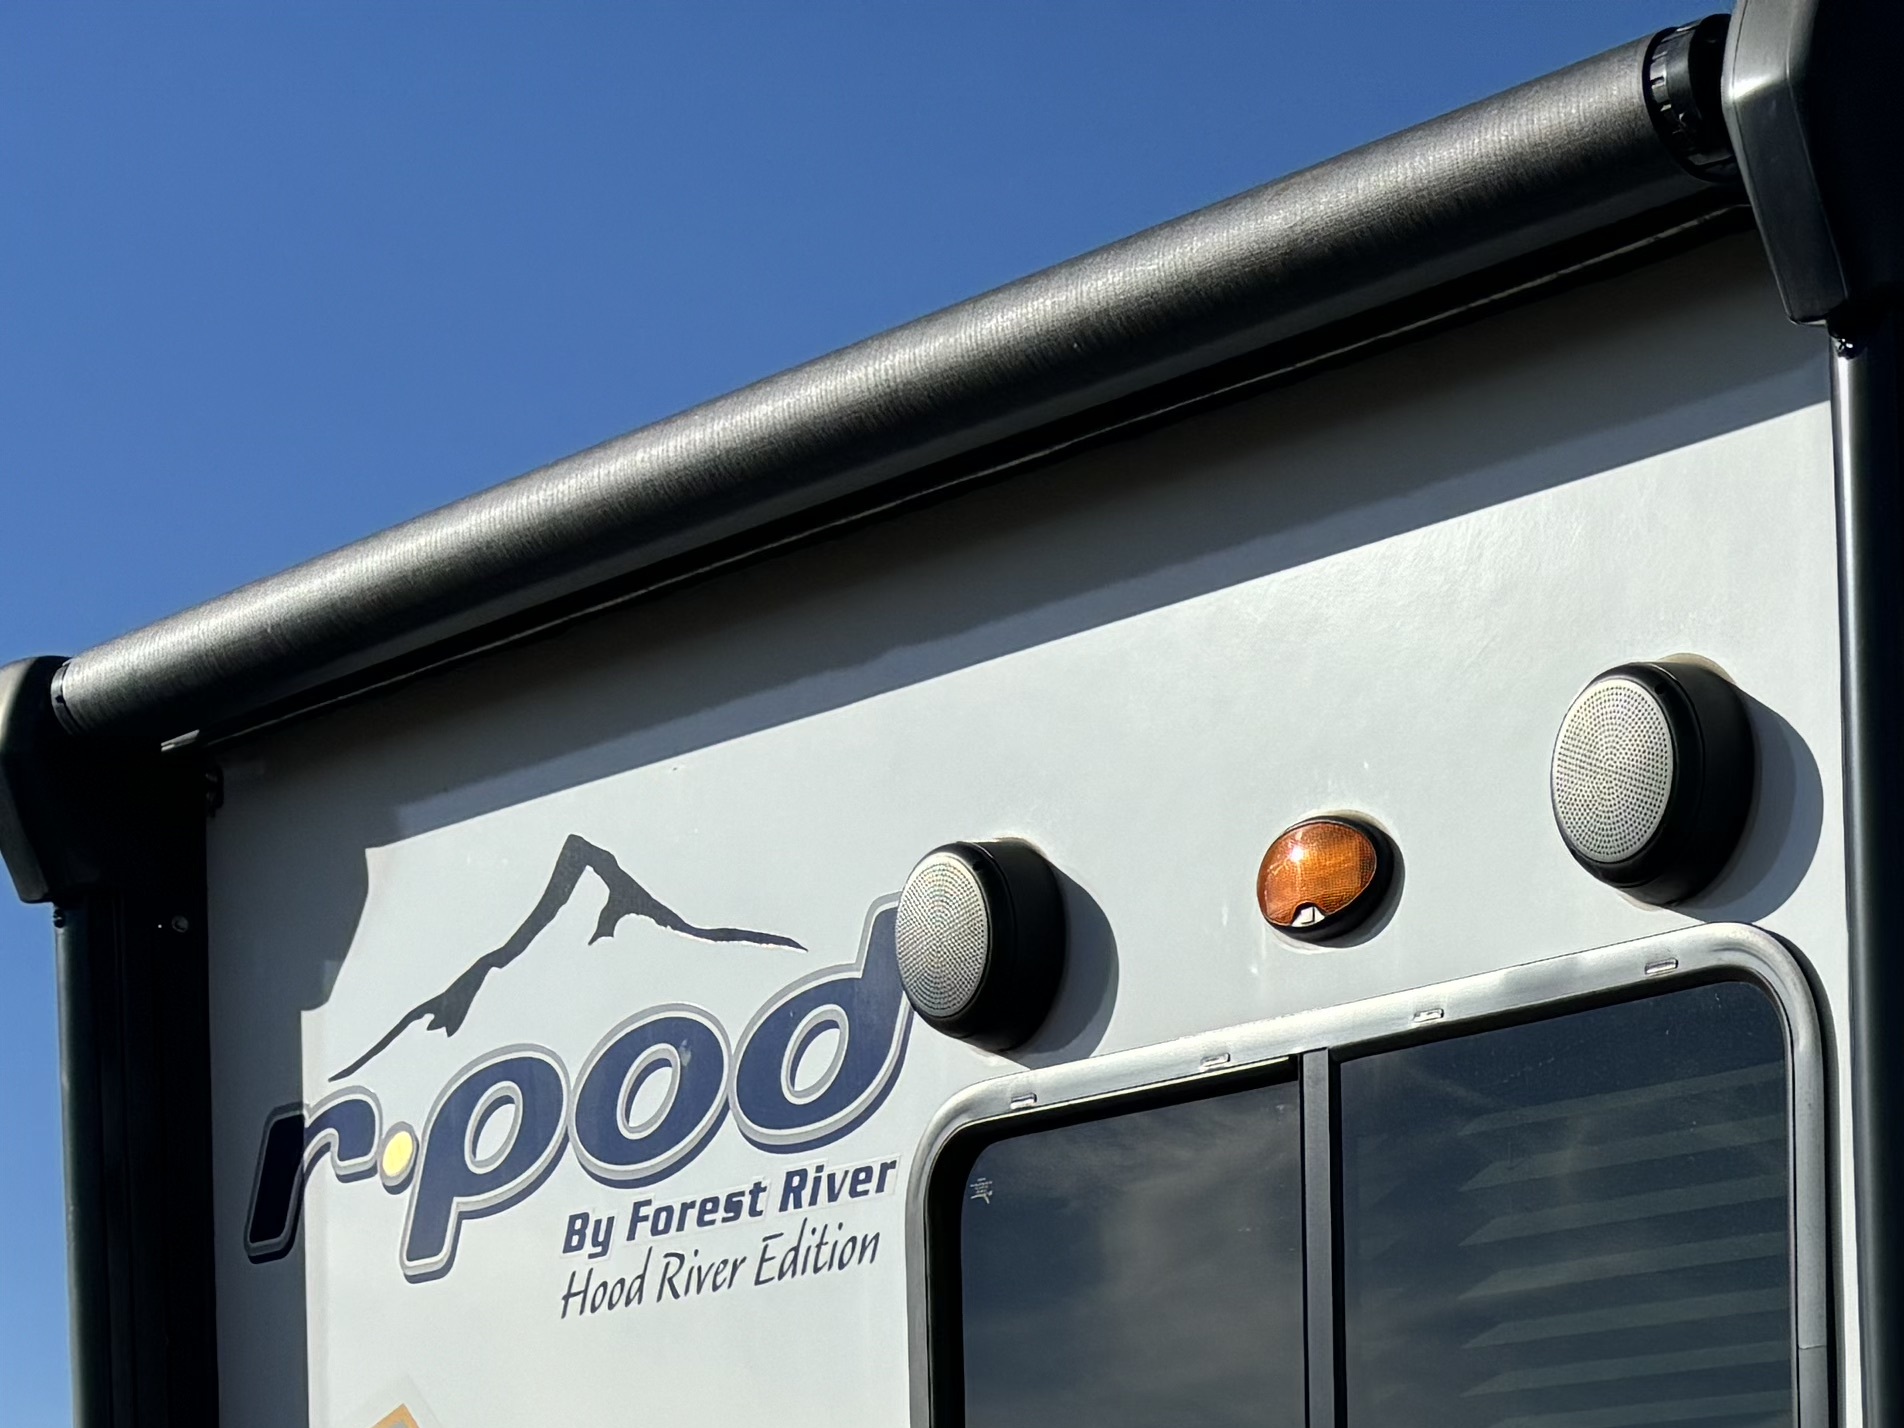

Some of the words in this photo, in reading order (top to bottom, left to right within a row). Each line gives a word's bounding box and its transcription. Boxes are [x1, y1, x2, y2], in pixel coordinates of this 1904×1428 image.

[563, 1212, 615, 1259] By
[626, 1181, 768, 1242] Forest
[779, 1159, 897, 1213] River
[561, 1246, 653, 1320] Hood
[656, 1248, 747, 1303] River
[754, 1217, 881, 1287] Edition
